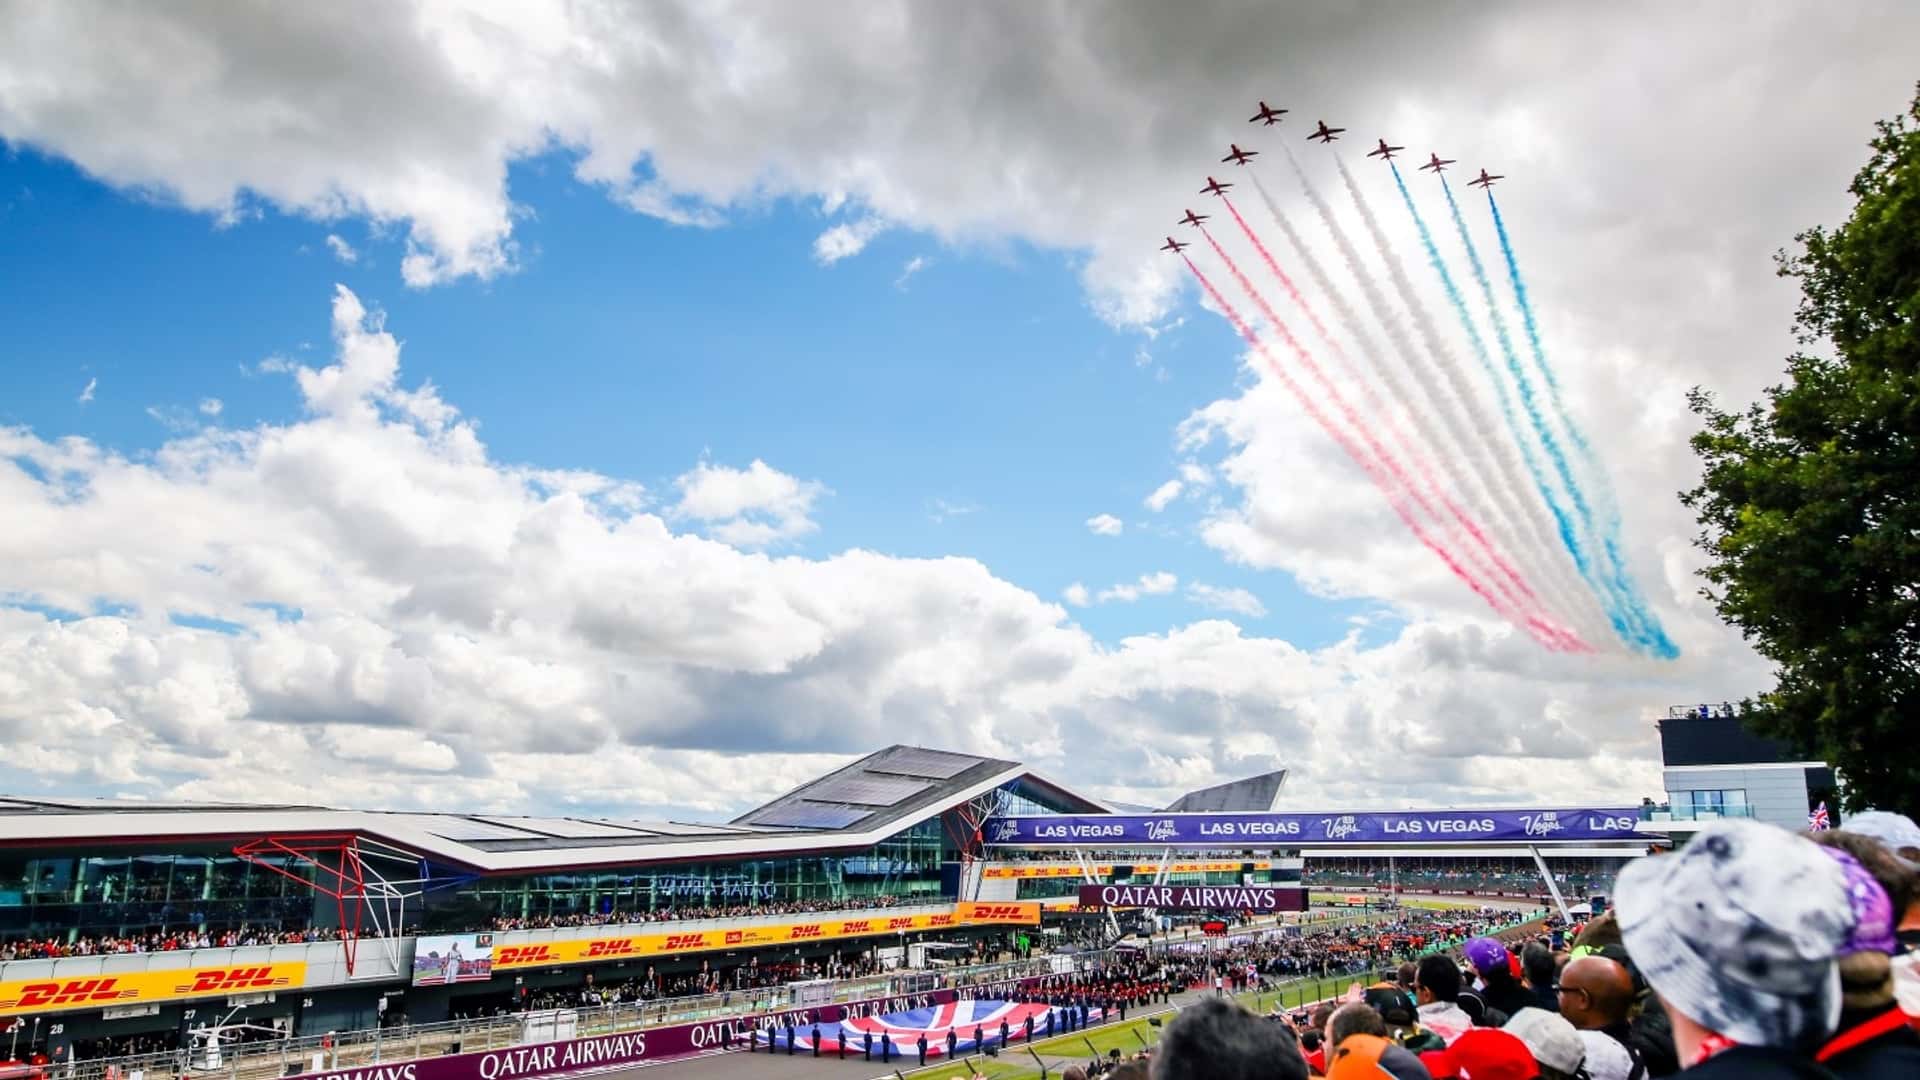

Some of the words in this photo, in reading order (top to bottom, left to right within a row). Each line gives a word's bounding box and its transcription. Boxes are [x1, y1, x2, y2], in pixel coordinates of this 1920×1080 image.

[1035, 825, 1067, 837] LAS
[1070, 825, 1124, 837] VEGAS
[1200, 822, 1235, 835] LAS
[1238, 822, 1300, 835] VEGAS
[1383, 820, 1423, 833] LAS
[1426, 819, 1495, 833] VEGAS
[1590, 817, 1633, 831] LAS
[1102, 886, 1175, 907] QATAR
[1180, 887, 1276, 908] AIRWAYS
[974, 905, 1023, 919] DHL
[889, 917, 913, 929] DHL
[930, 914, 952, 925] DHL
[791, 924, 821, 938] DHL
[843, 921, 869, 933] DHL
[588, 939, 633, 957] DHL
[666, 933, 704, 949] DHL
[498, 945, 550, 965] DHL
[191, 966, 275, 992] DHL
[16, 978, 121, 1007] DHL
[184, 1009, 197, 1020] 27
[49, 1023, 64, 1035] 28
[479, 1046, 557, 1079] QATAR
[561, 1033, 646, 1067] AIRWAYS
